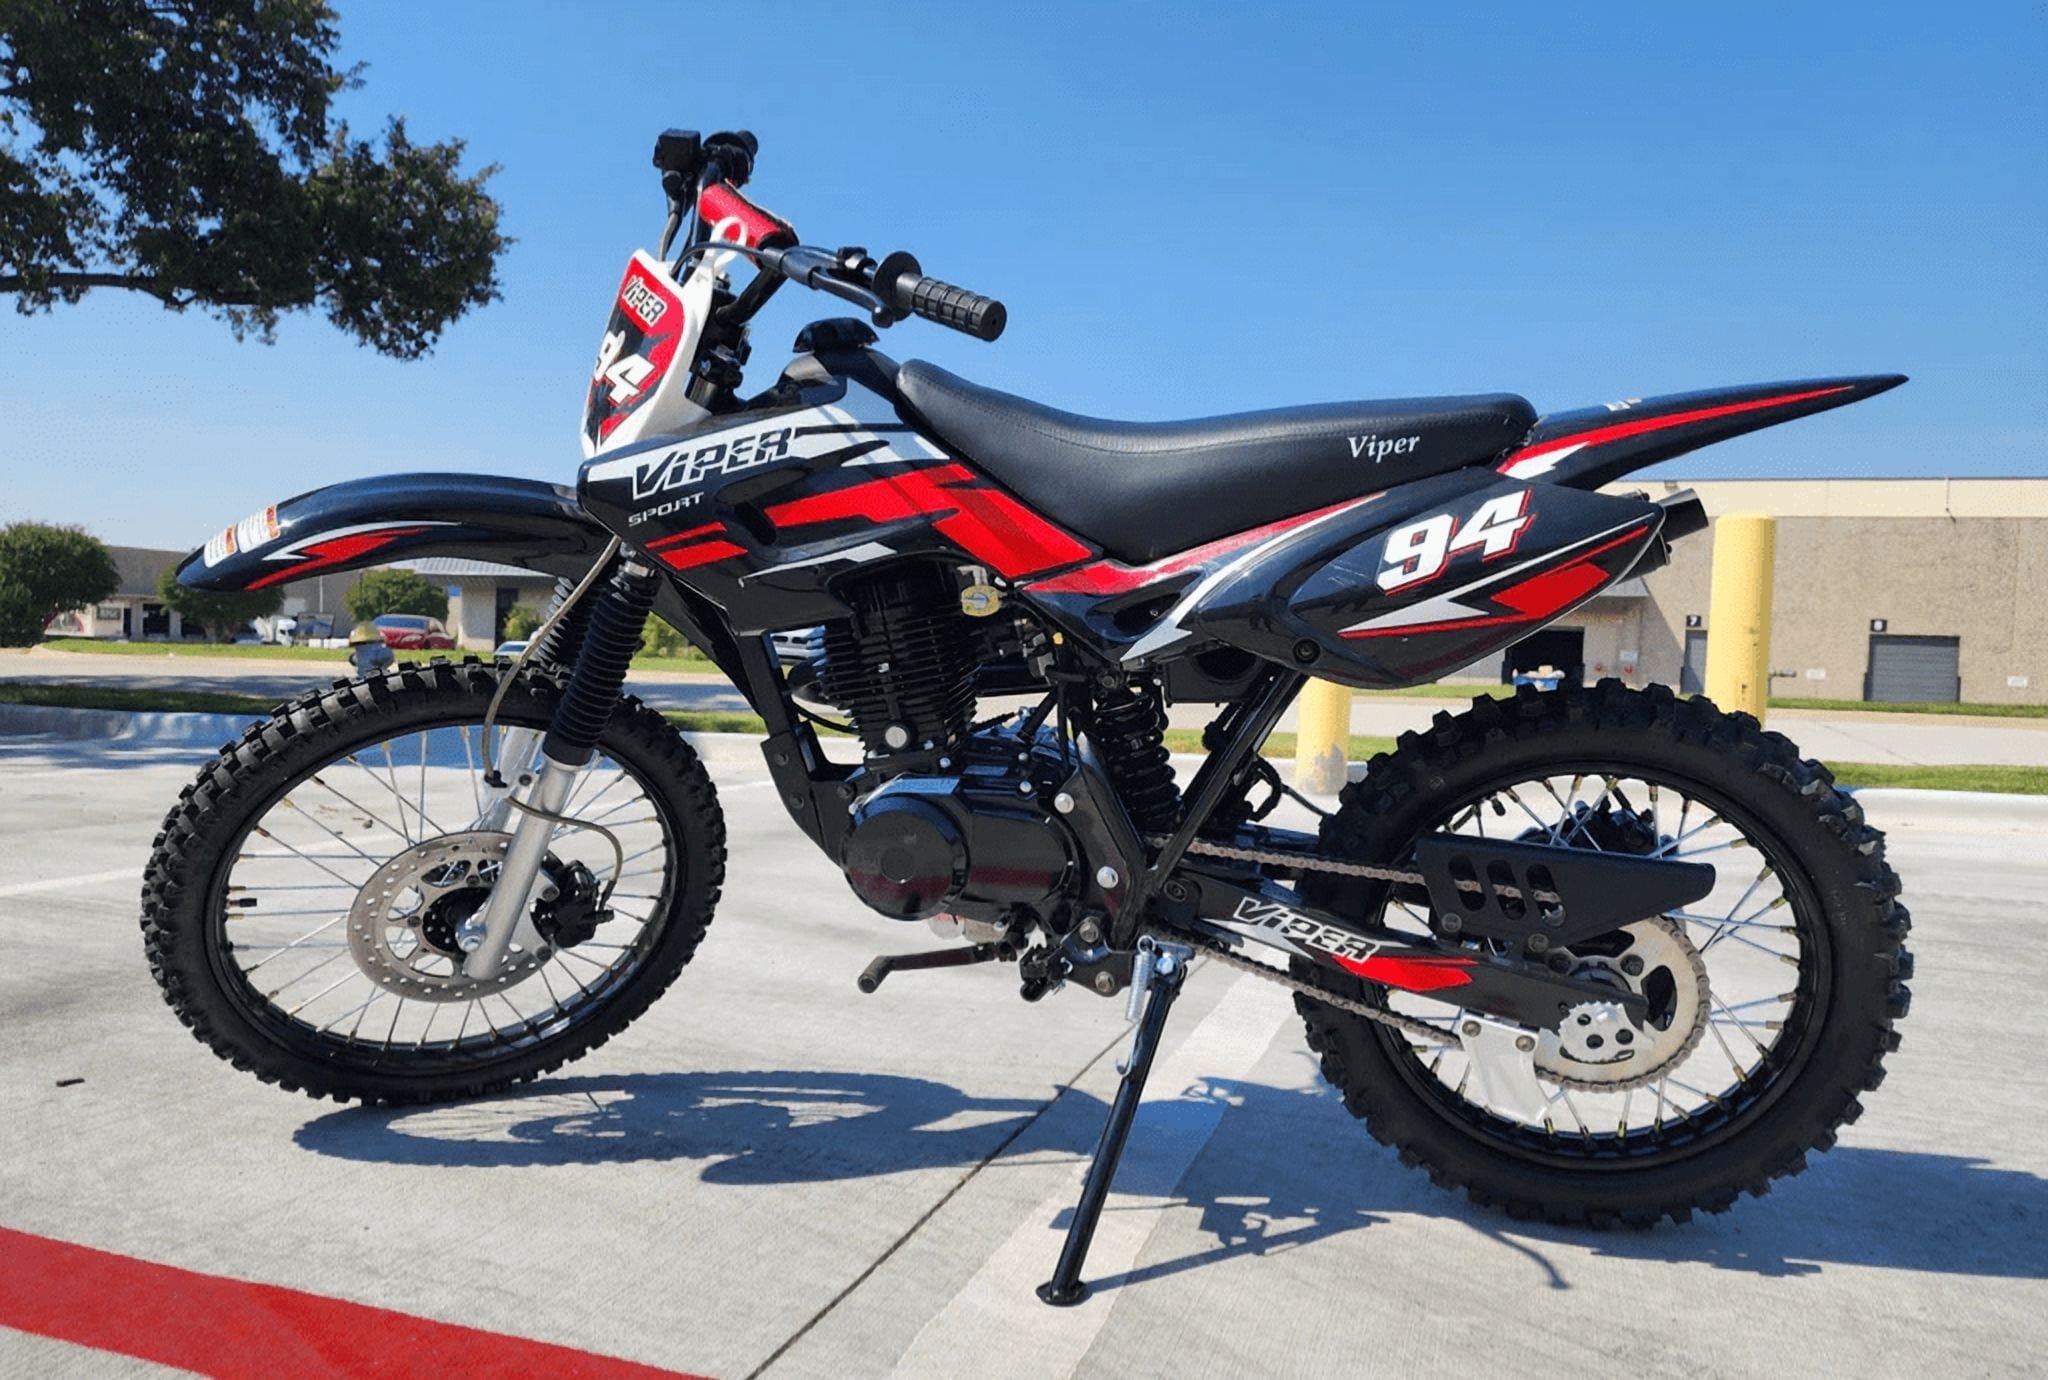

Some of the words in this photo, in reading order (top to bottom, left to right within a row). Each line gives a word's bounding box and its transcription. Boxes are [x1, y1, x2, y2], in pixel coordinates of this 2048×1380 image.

[593, 330, 656, 404] 94
[1347, 434, 1420, 463] Viper
[628, 491, 704, 527] SPORT
[1376, 489, 1537, 596] 94
